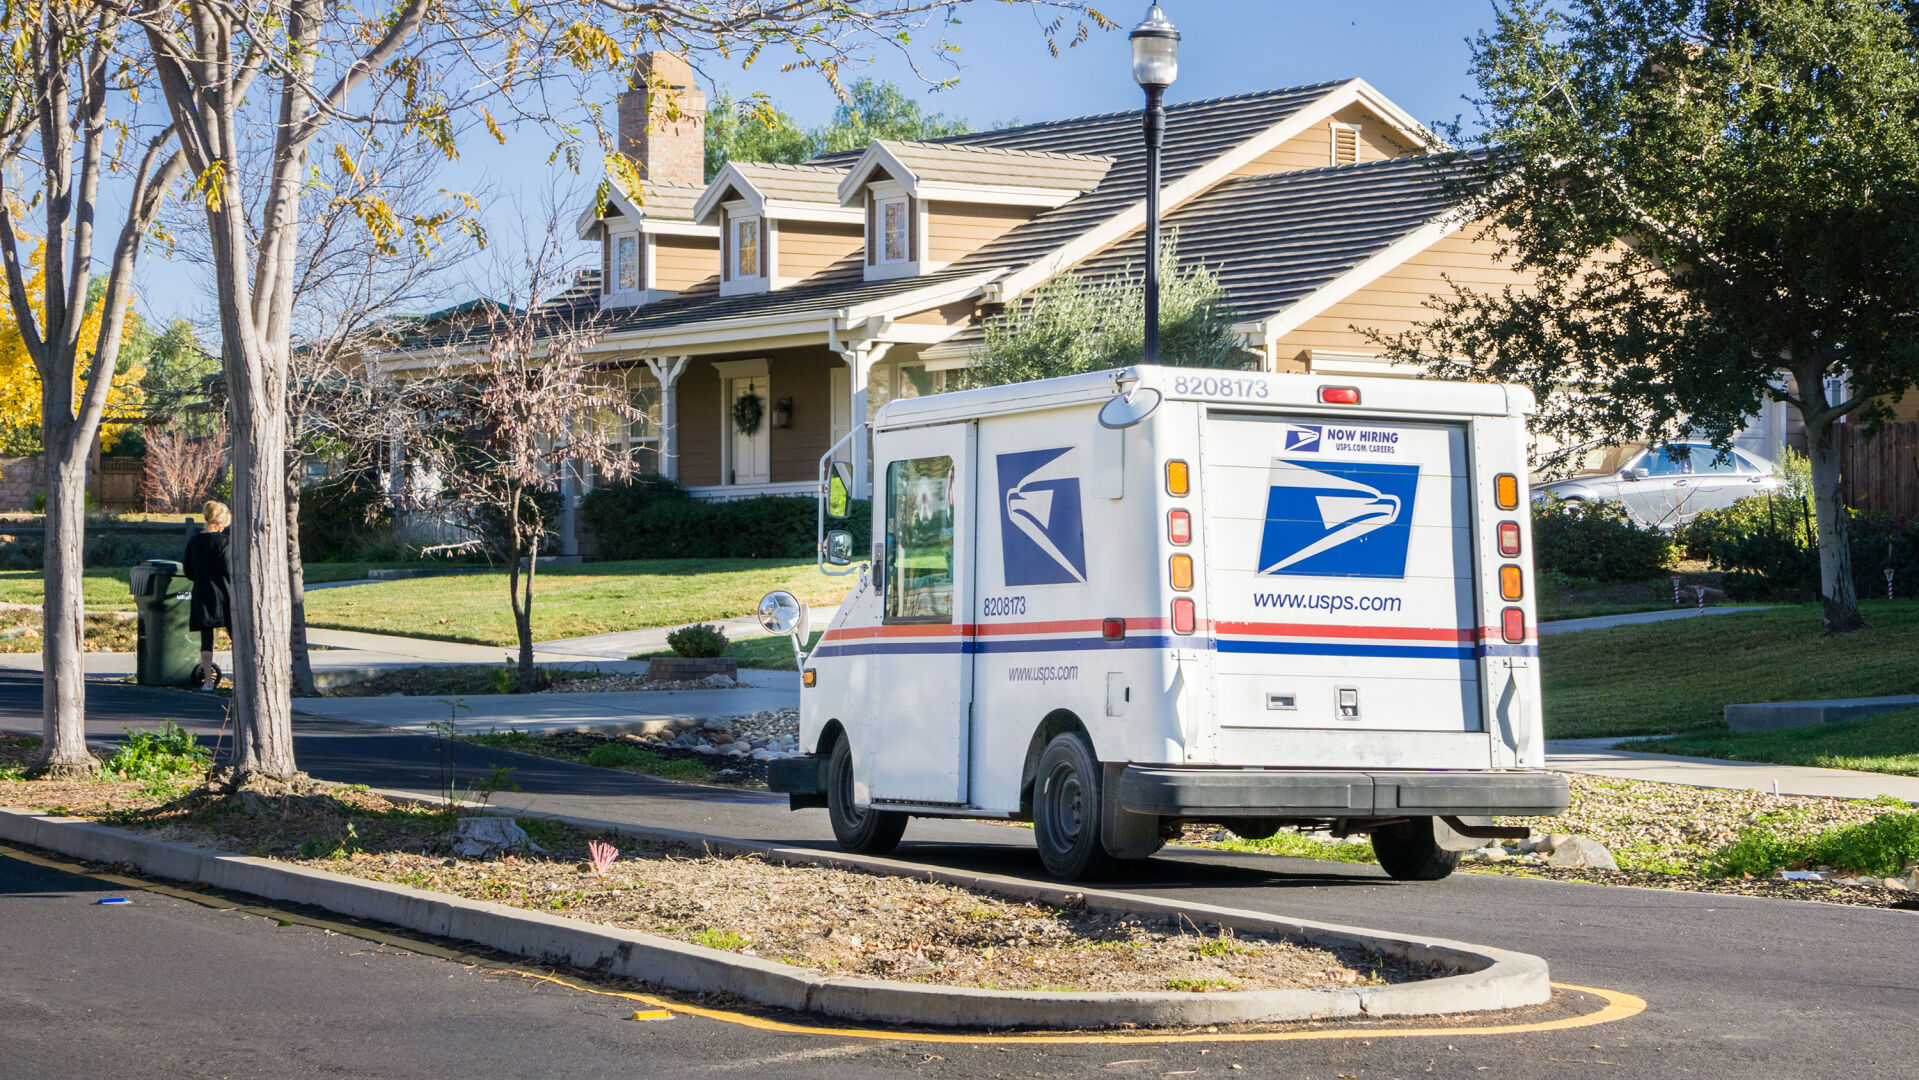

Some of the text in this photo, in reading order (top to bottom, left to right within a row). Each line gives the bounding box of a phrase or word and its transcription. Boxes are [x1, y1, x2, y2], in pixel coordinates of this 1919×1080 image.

[1175, 376, 1268, 398] 8208173
[1327, 429, 1399, 443] NOW HIRING
[984, 596, 1026, 616] 8208173
[1253, 592, 1401, 614] www.usps.com
[1009, 666, 1078, 684] www.usps.com
